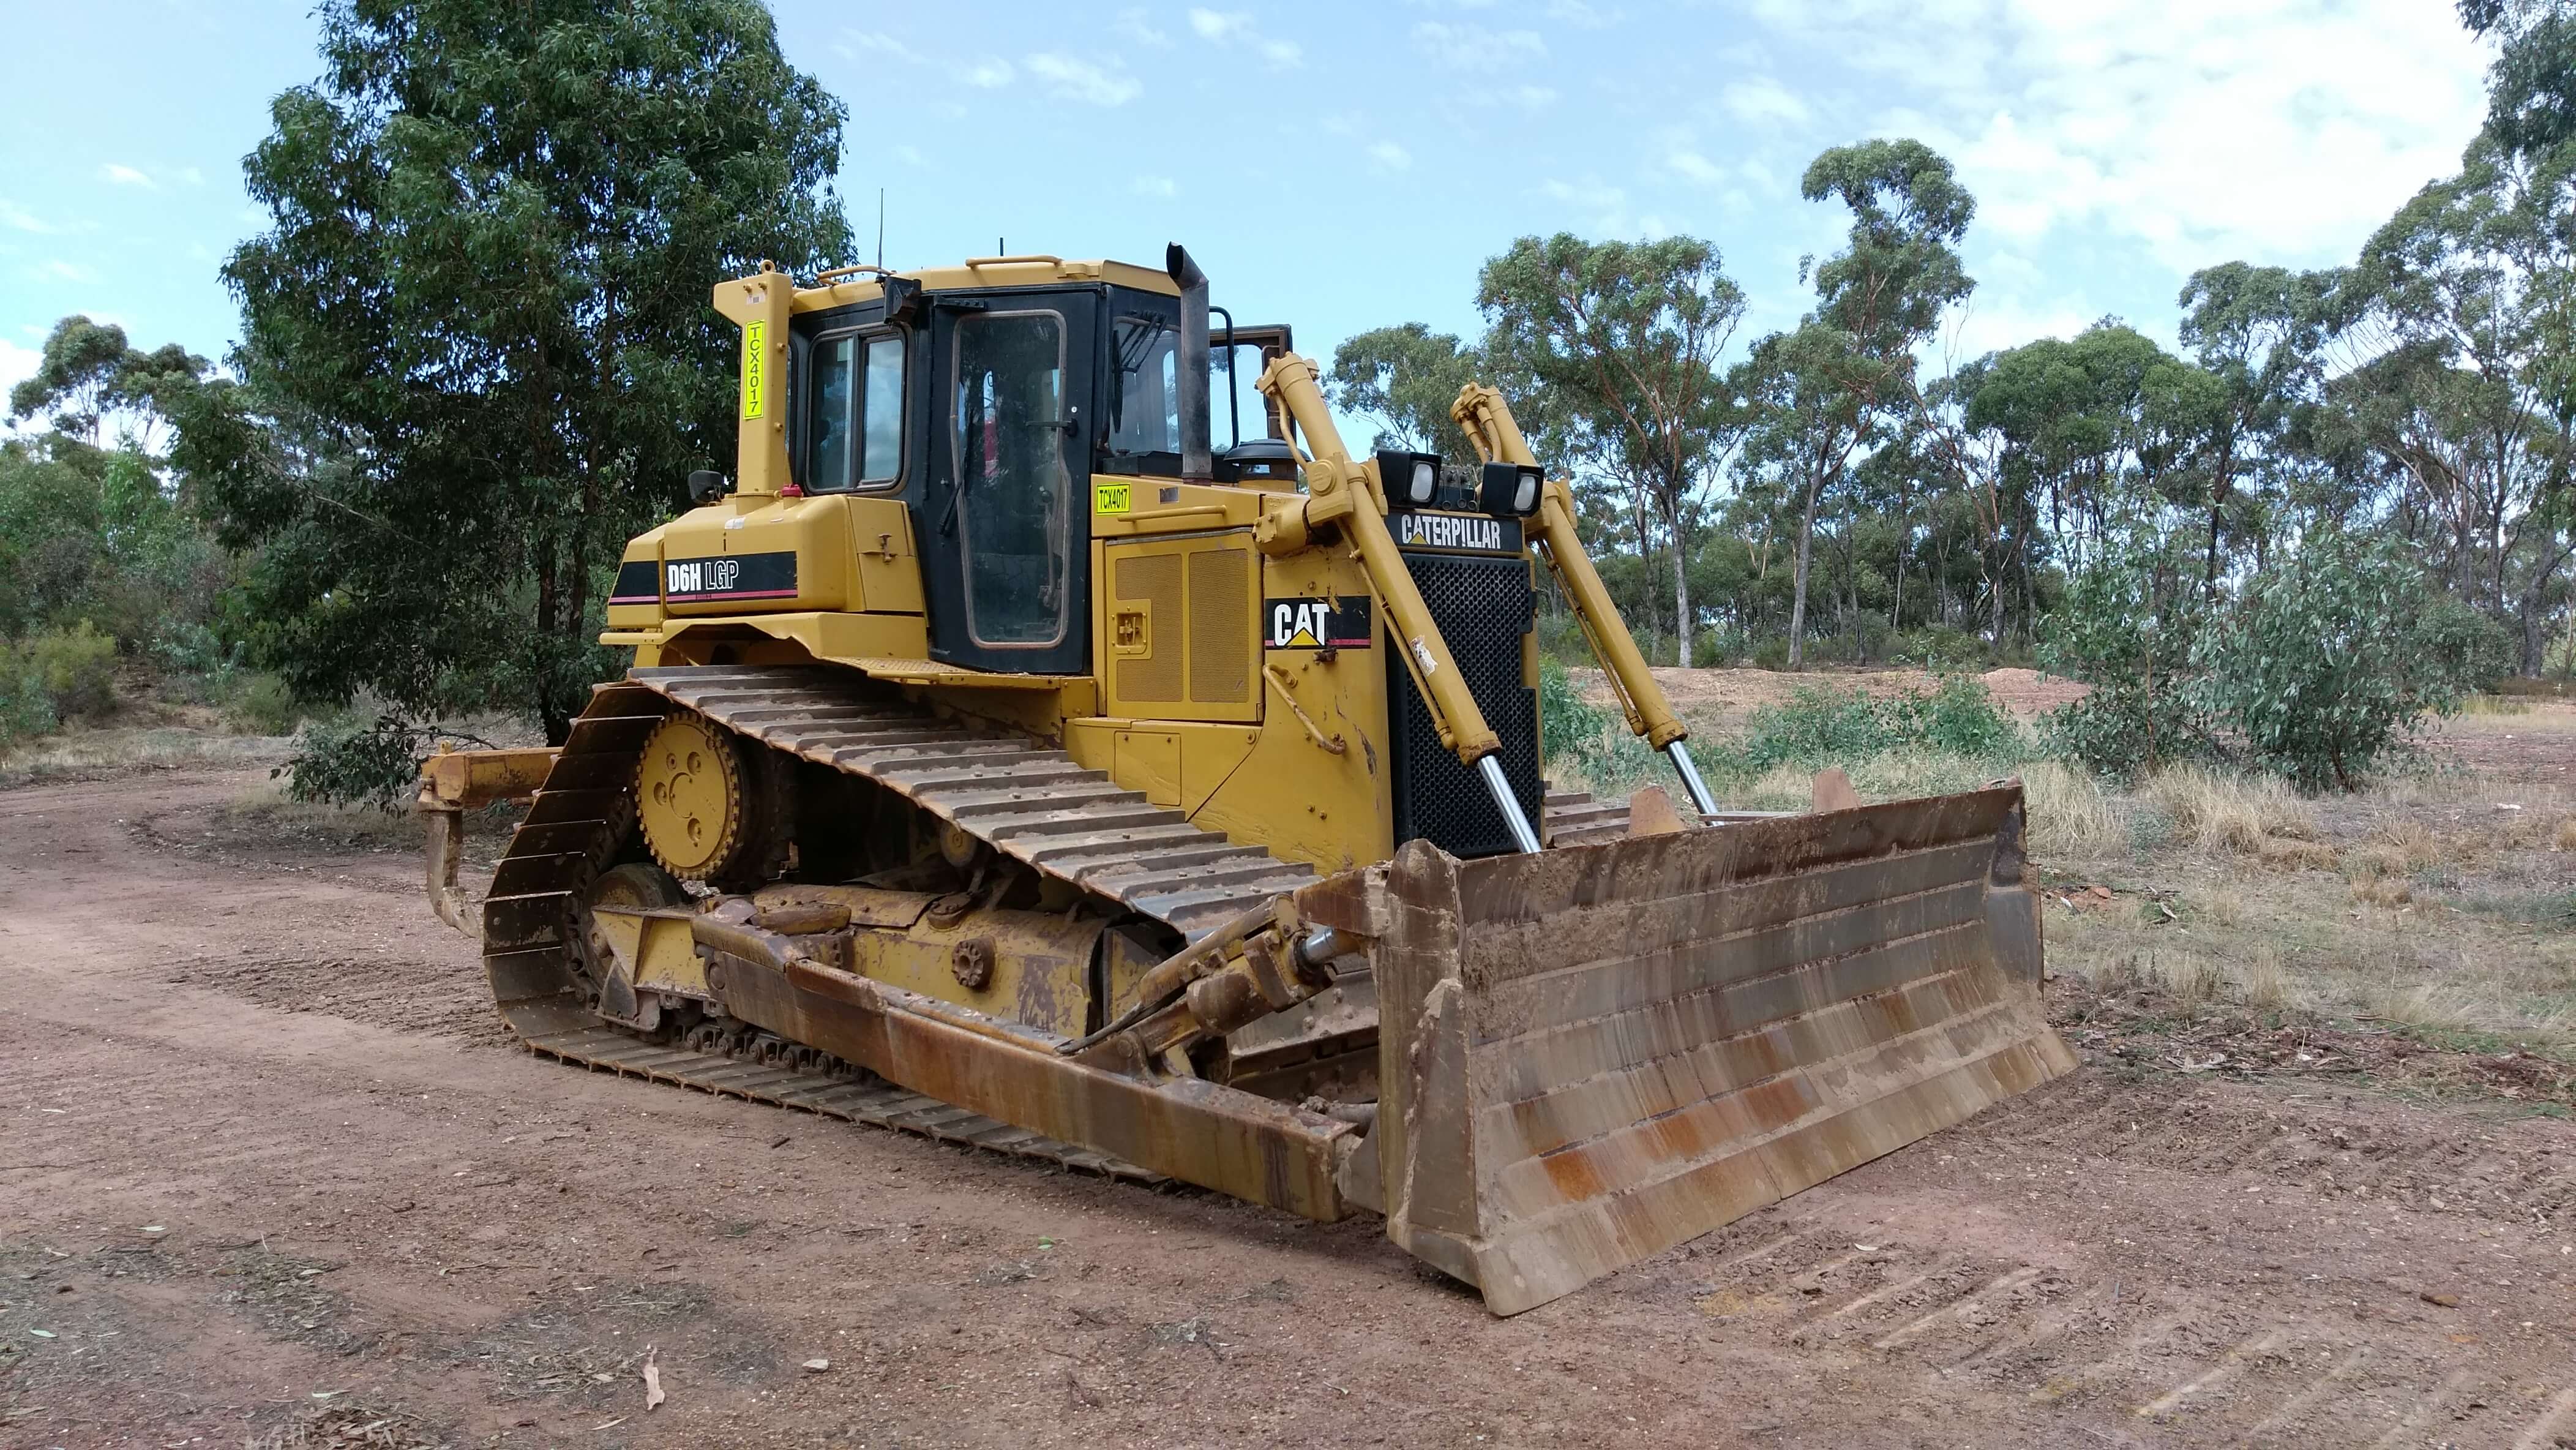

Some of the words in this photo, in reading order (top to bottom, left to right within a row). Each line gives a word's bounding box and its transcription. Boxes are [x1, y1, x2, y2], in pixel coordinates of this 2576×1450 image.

[749, 326, 761, 412] TCX4017
[1099, 489, 1127, 509] TCX4017
[1401, 514, 1501, 549] CATERPILLAR
[668, 563, 702, 592] D6H
[705, 560, 739, 590] LGP
[1275, 604, 1330, 646] CAT
